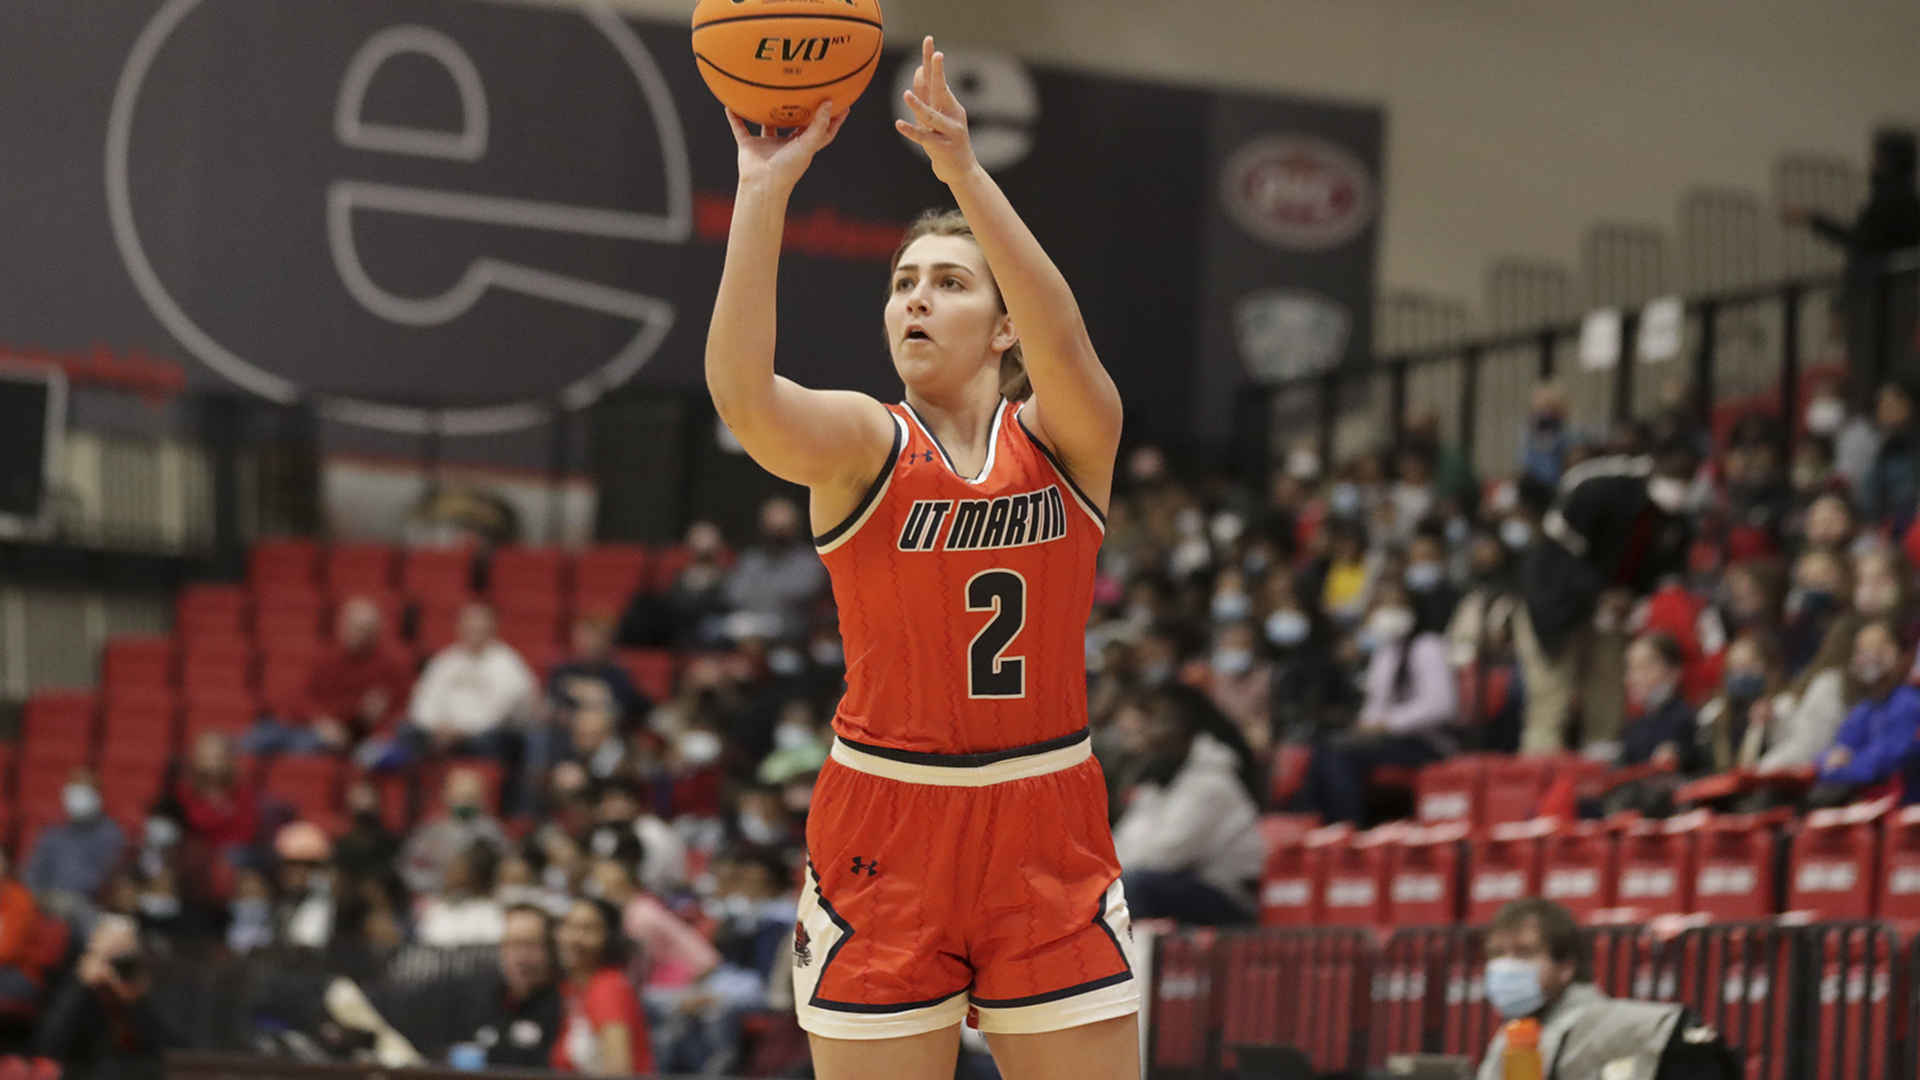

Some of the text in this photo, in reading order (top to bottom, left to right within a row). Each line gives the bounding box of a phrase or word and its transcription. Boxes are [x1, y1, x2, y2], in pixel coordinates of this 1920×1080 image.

[754, 37, 831, 62] EVO
[897, 484, 1066, 552] UT MARTIN
[965, 568, 1026, 699] 2
